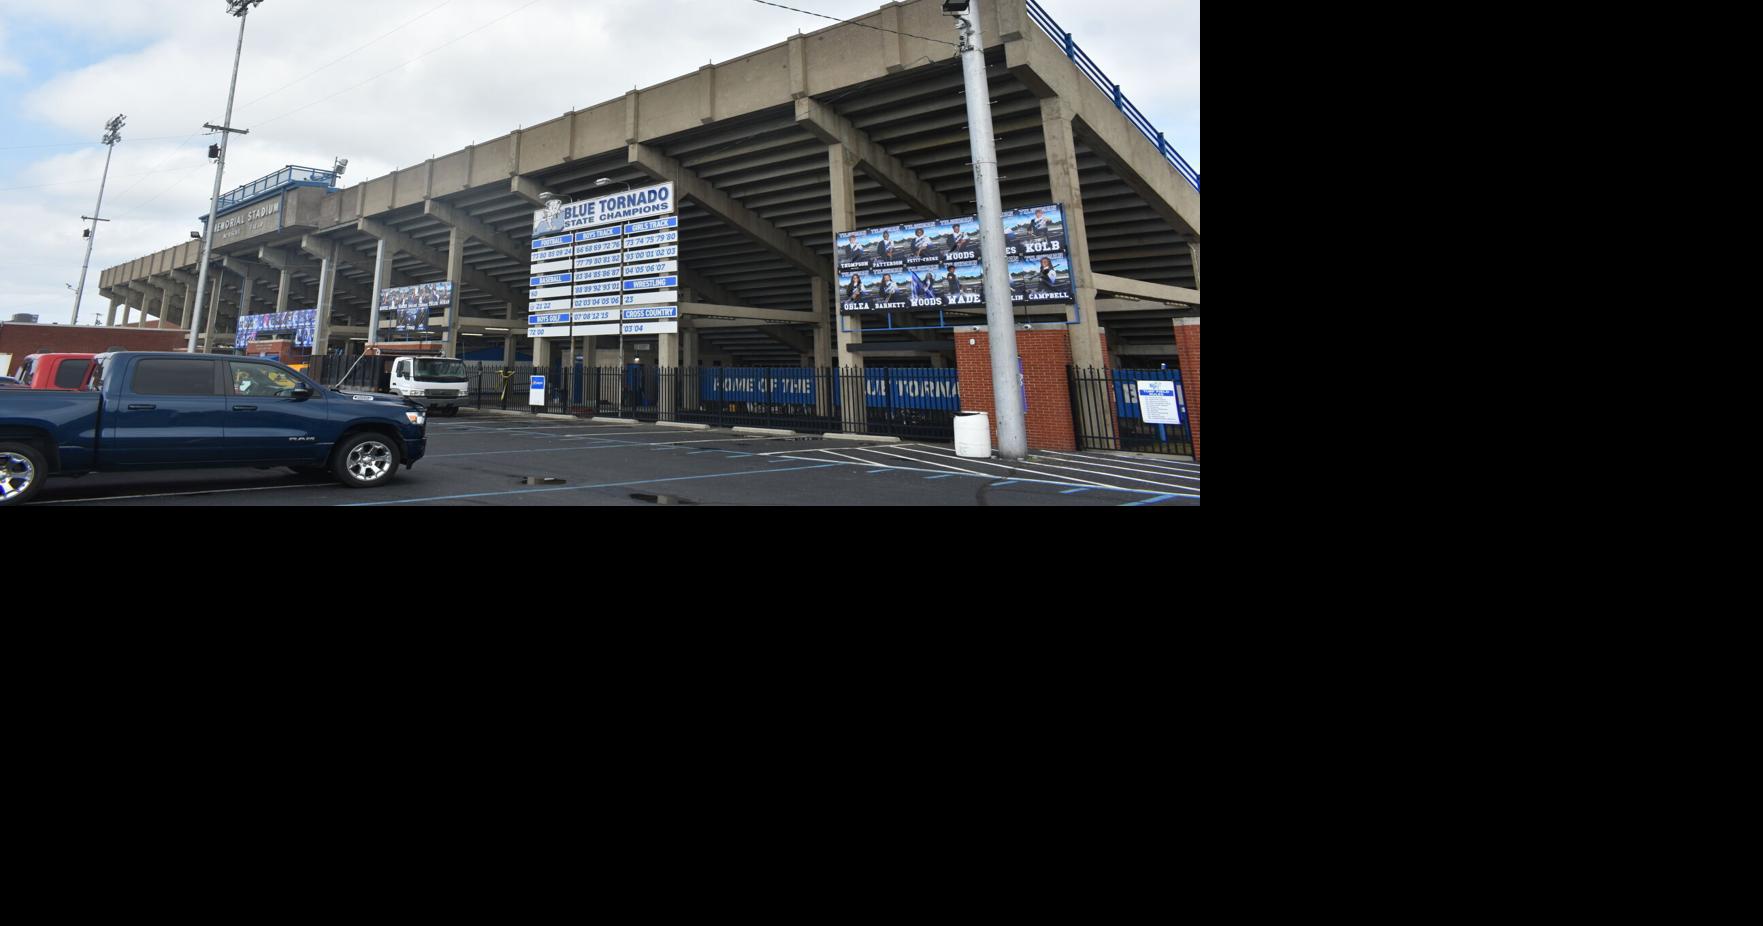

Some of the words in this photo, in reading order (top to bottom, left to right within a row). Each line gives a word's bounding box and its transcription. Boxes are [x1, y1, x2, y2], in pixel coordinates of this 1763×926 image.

[564, 202, 595, 220] BLUE
[600, 187, 669, 212] TORNADO
[247, 201, 279, 221] STADIUM
[564, 216, 595, 228] STATE
[600, 202, 668, 222] CHAMPIONS
[632, 222, 649, 231] GIRLS
[1025, 240, 1060, 253] KOLB
[946, 251, 975, 261] WOODS
[841, 261, 869, 269] THOMPSON
[633, 279, 666, 288] WRESTLING
[947, 294, 981, 305] WADE
[1028, 292, 1069, 300] CAMPBELL
[844, 302, 870, 310] OBLEA
[910, 298, 942, 307] WOODS
[645, 308, 674, 317] COUNTRY
[782, 378, 811, 395] THE
